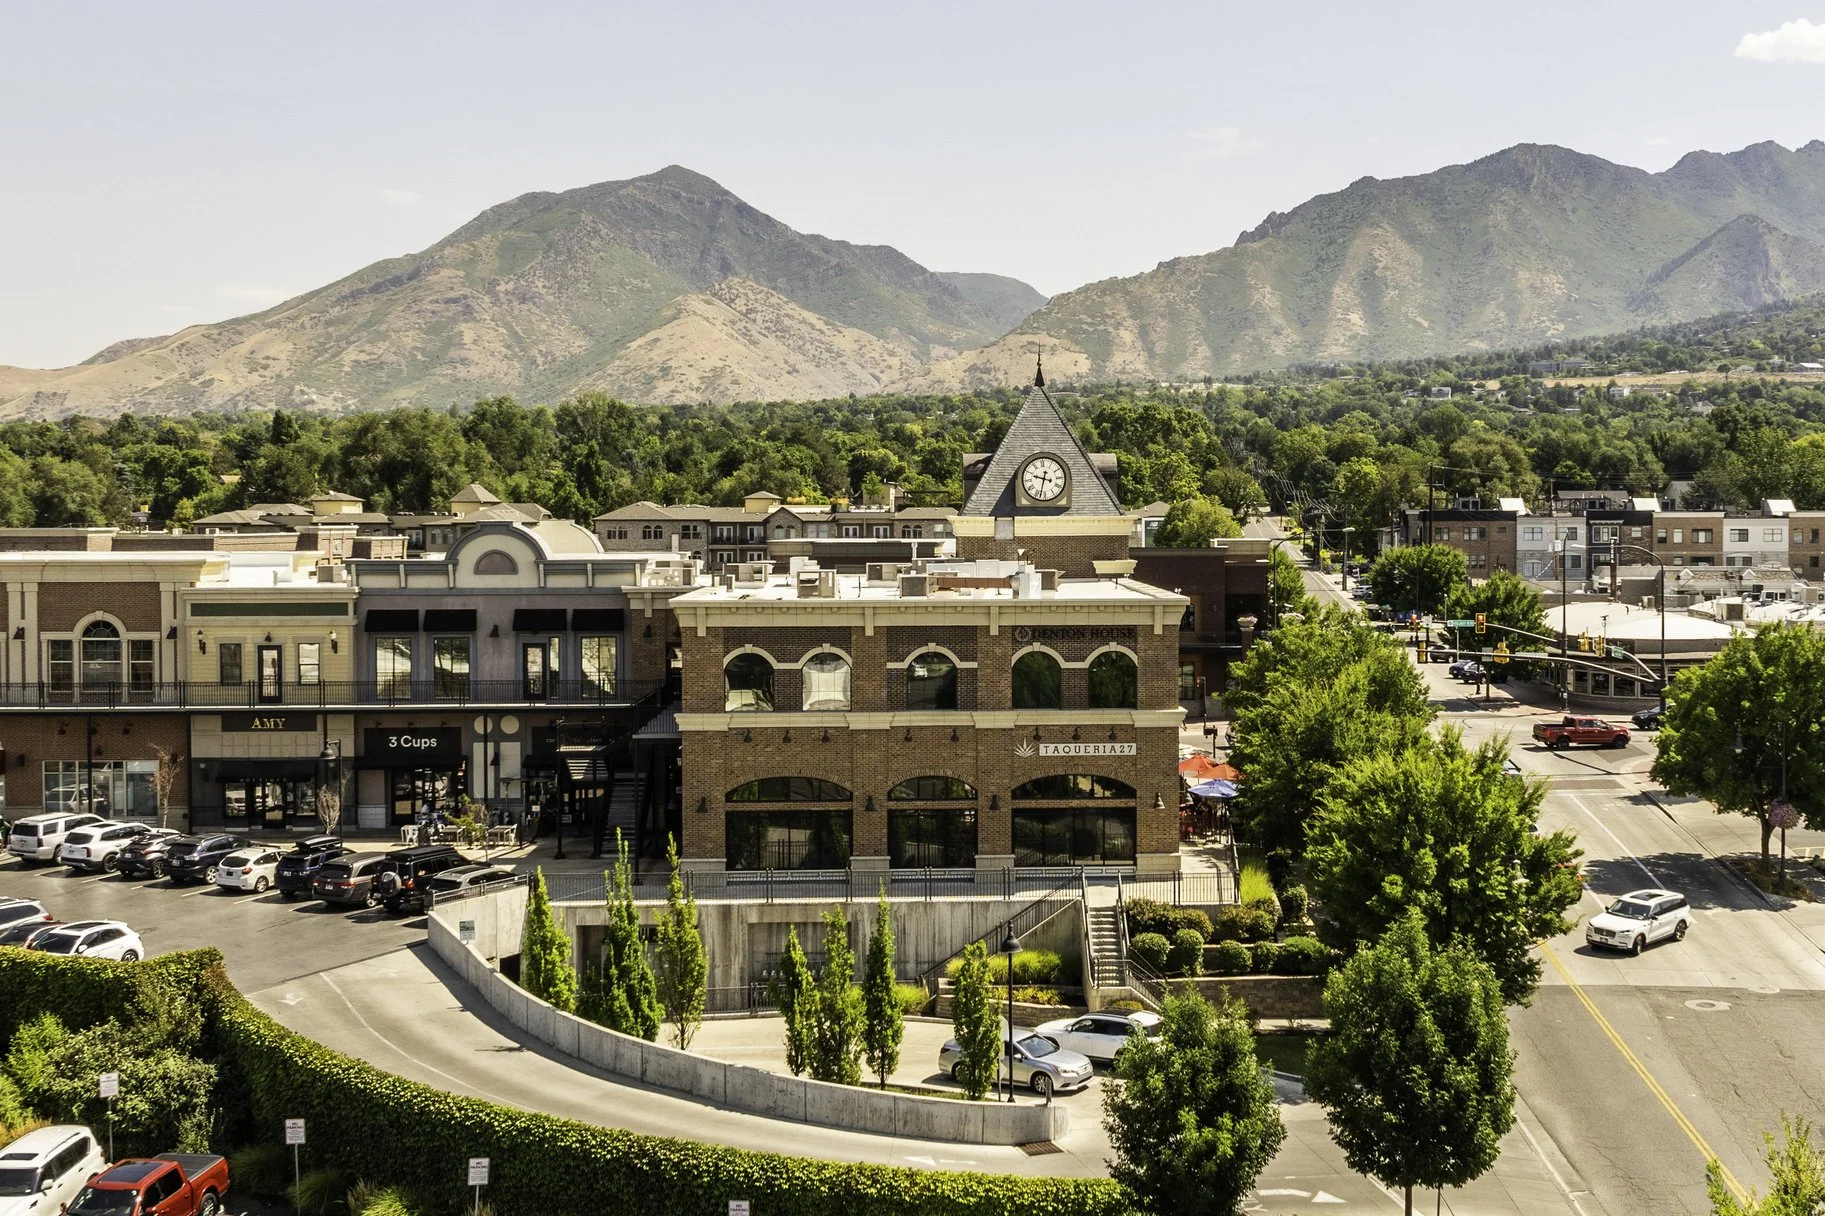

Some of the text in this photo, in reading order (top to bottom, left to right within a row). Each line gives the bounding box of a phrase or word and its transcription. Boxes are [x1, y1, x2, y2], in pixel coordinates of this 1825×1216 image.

[1032, 628, 1136, 639] DENTON HOUSE
[251, 717, 286, 729] AMY
[388, 735, 438, 750] 3 Cups
[1043, 745, 1134, 755] TAQUERIA27
